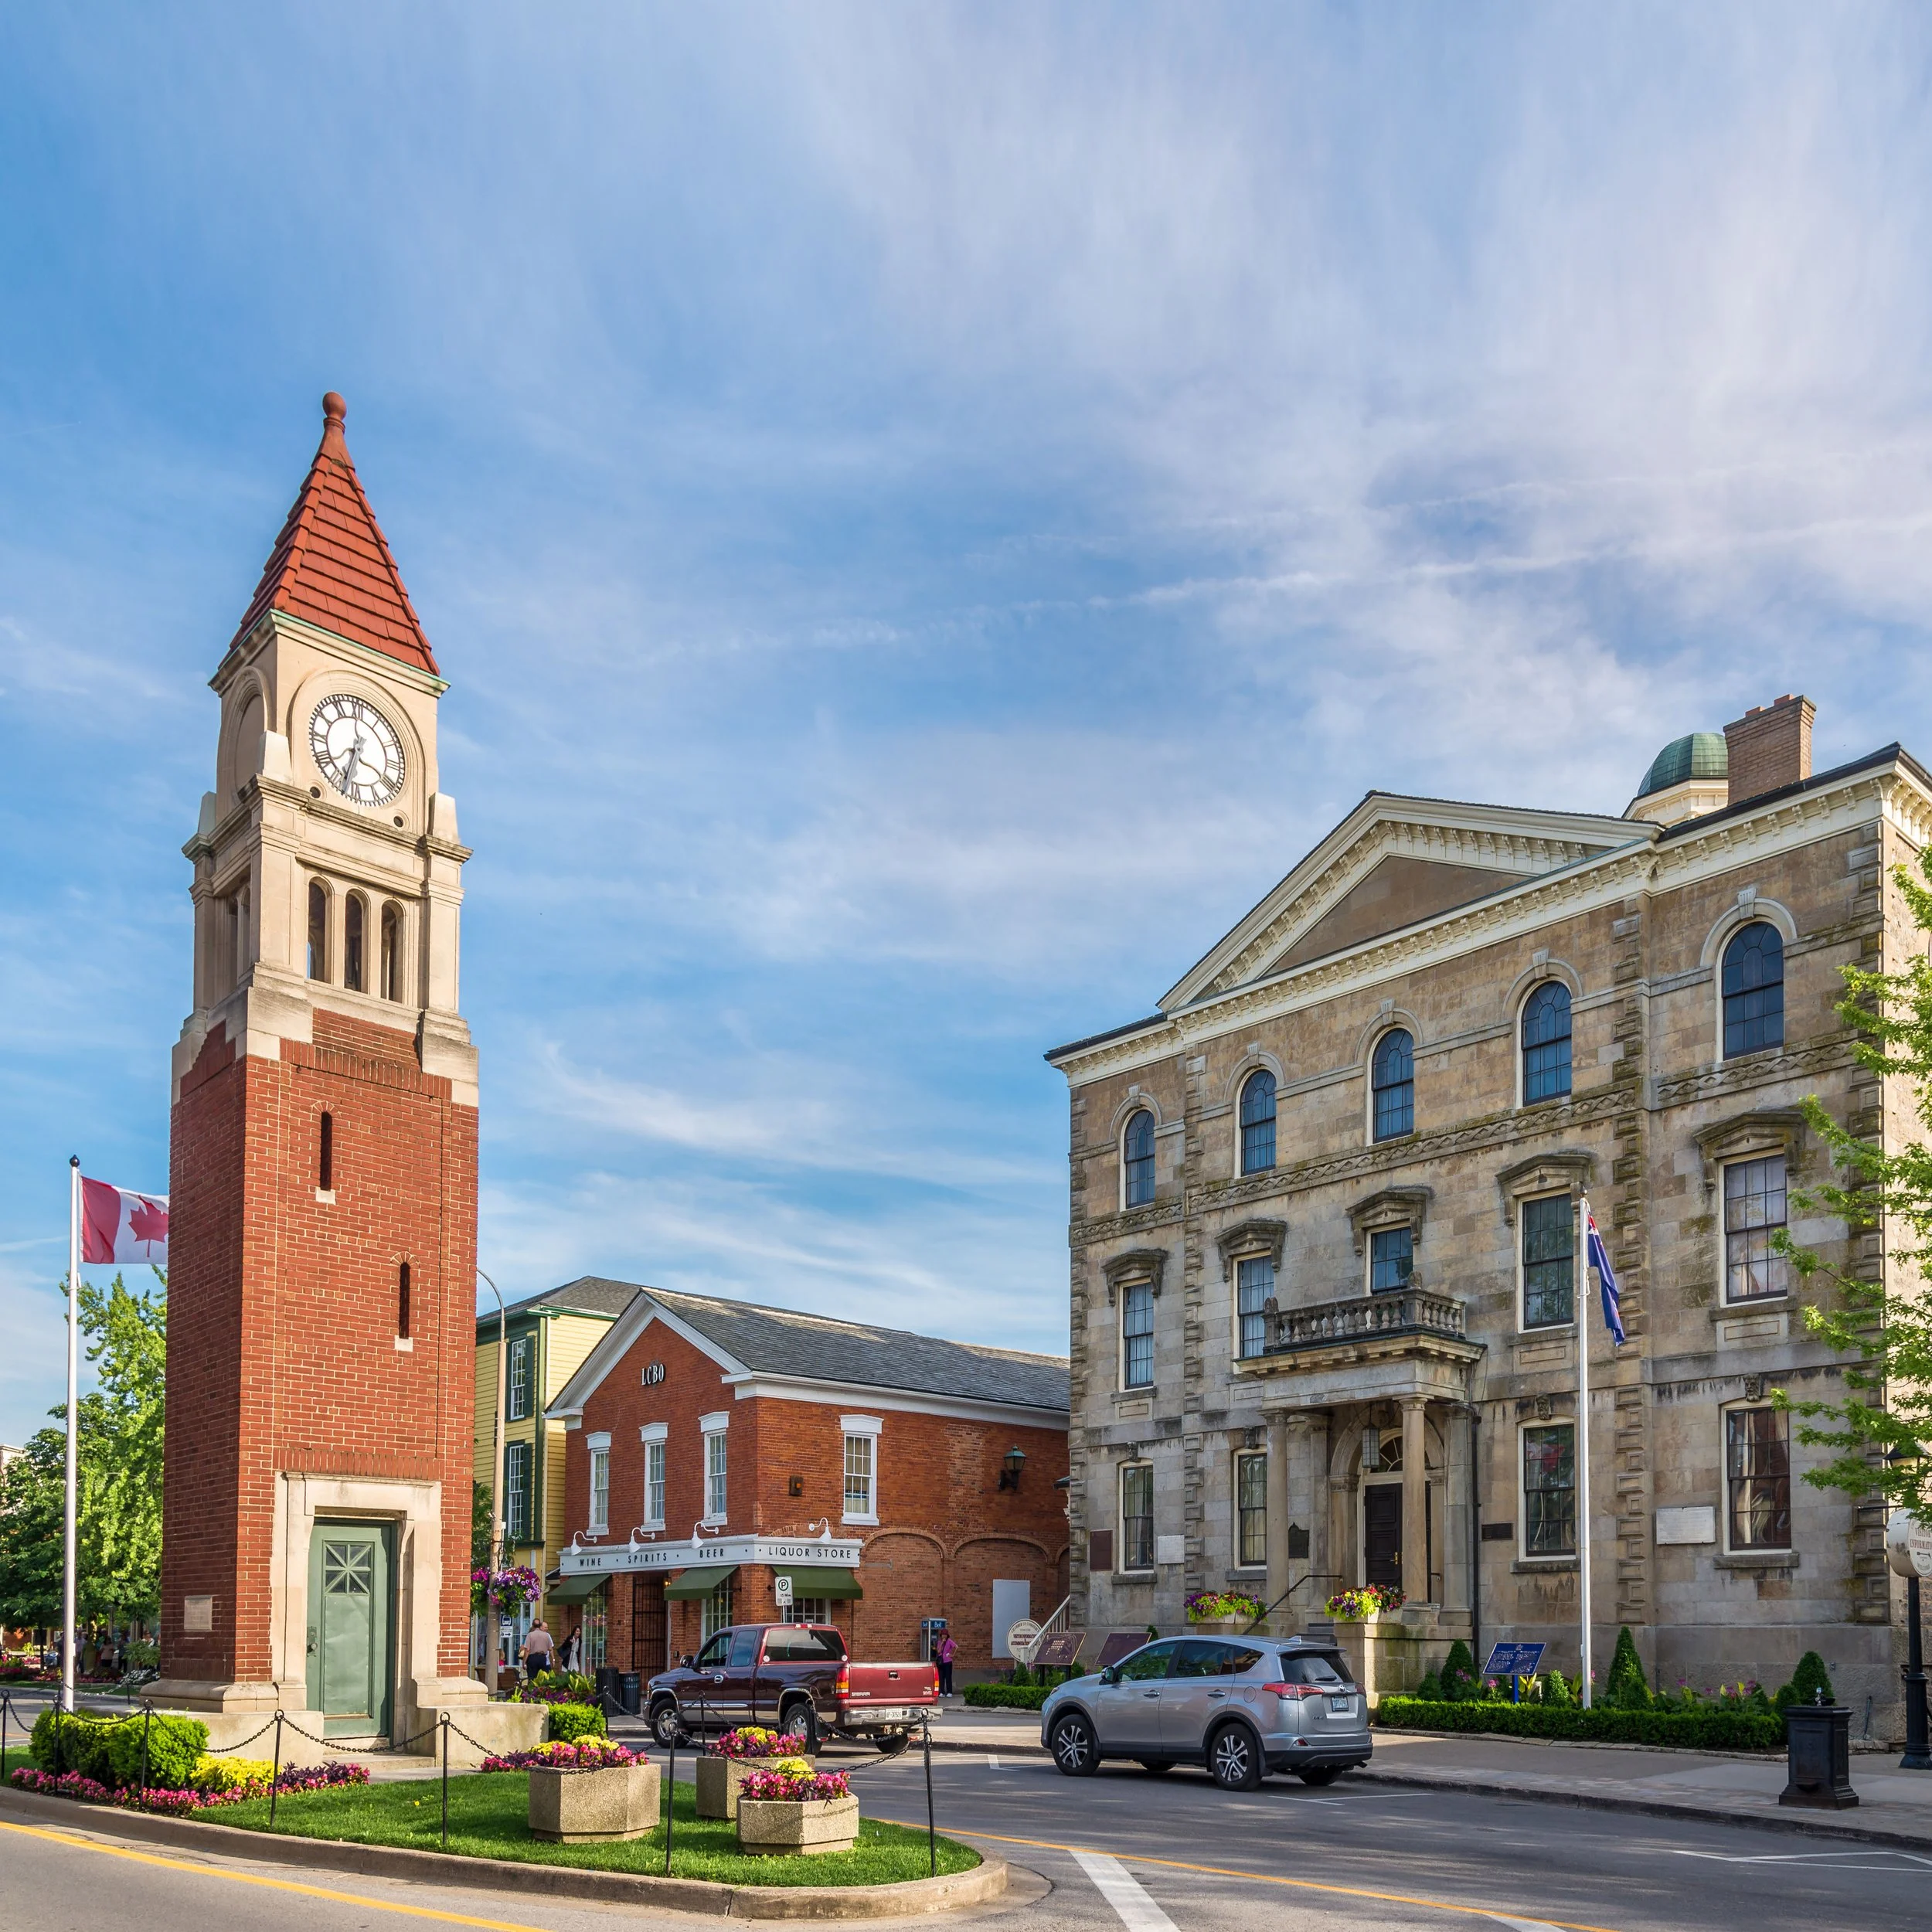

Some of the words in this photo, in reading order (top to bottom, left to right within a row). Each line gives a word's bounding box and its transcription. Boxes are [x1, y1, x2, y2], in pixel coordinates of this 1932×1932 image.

[641, 1363, 665, 1386] LCBO
[580, 1557, 601, 1566] WINE
[628, 1553, 667, 1563] SPIRITS
[699, 1548, 724, 1558] BEER
[768, 1546, 810, 1557] LIQUOR
[817, 1549, 851, 1559] STORE
